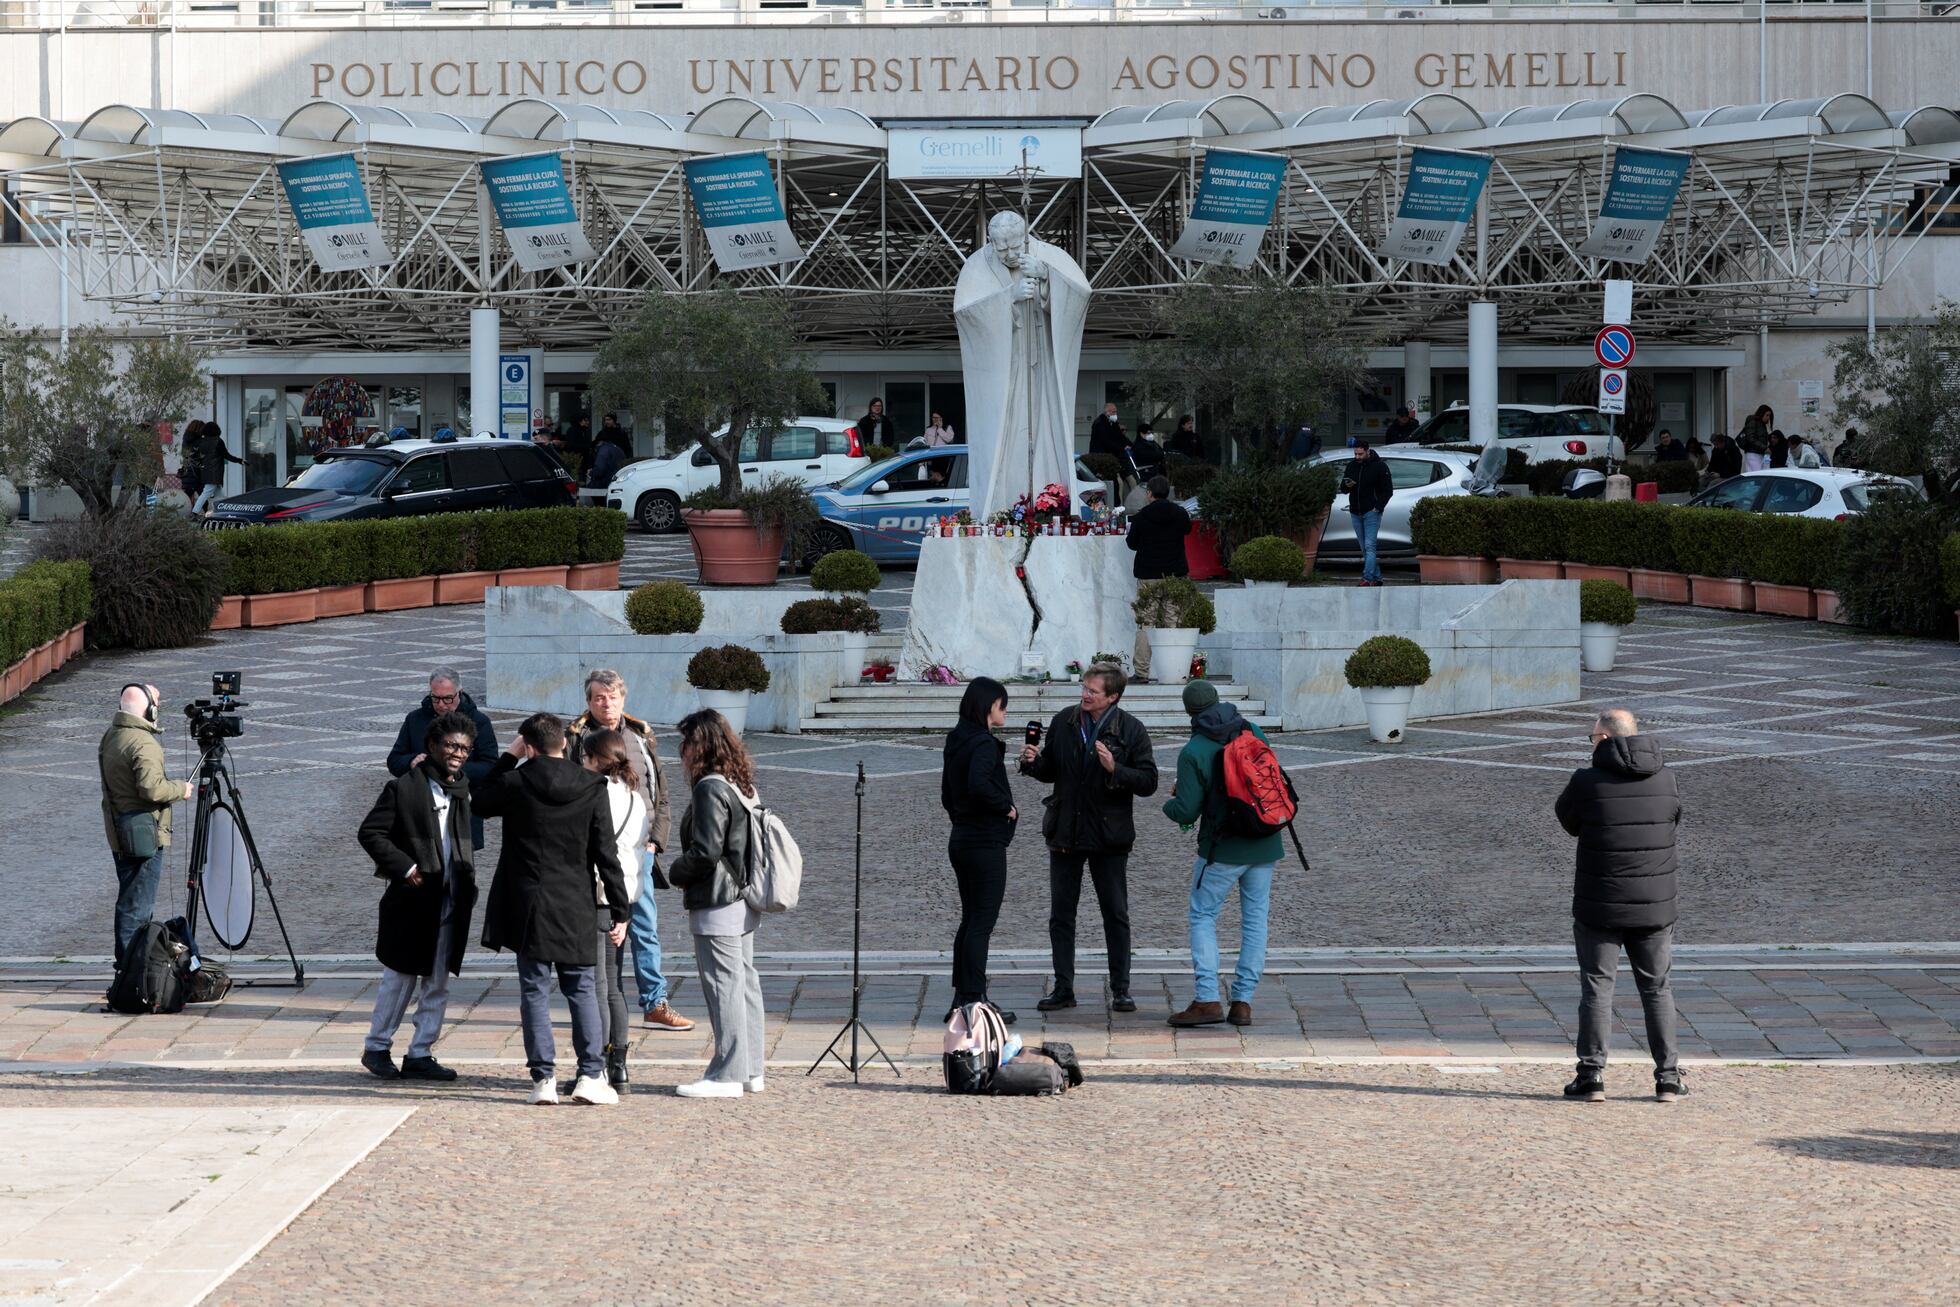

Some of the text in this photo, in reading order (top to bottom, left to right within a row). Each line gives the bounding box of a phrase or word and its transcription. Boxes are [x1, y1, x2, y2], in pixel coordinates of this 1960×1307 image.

[310, 52, 1628, 98] POLICLINICO UNIVERSITARIO AGOSTINO GEMELLI
[920, 136, 1002, 156] Gemelli
[512, 368, 518, 378] E
[217, 502, 265, 512] CARABINIERI
